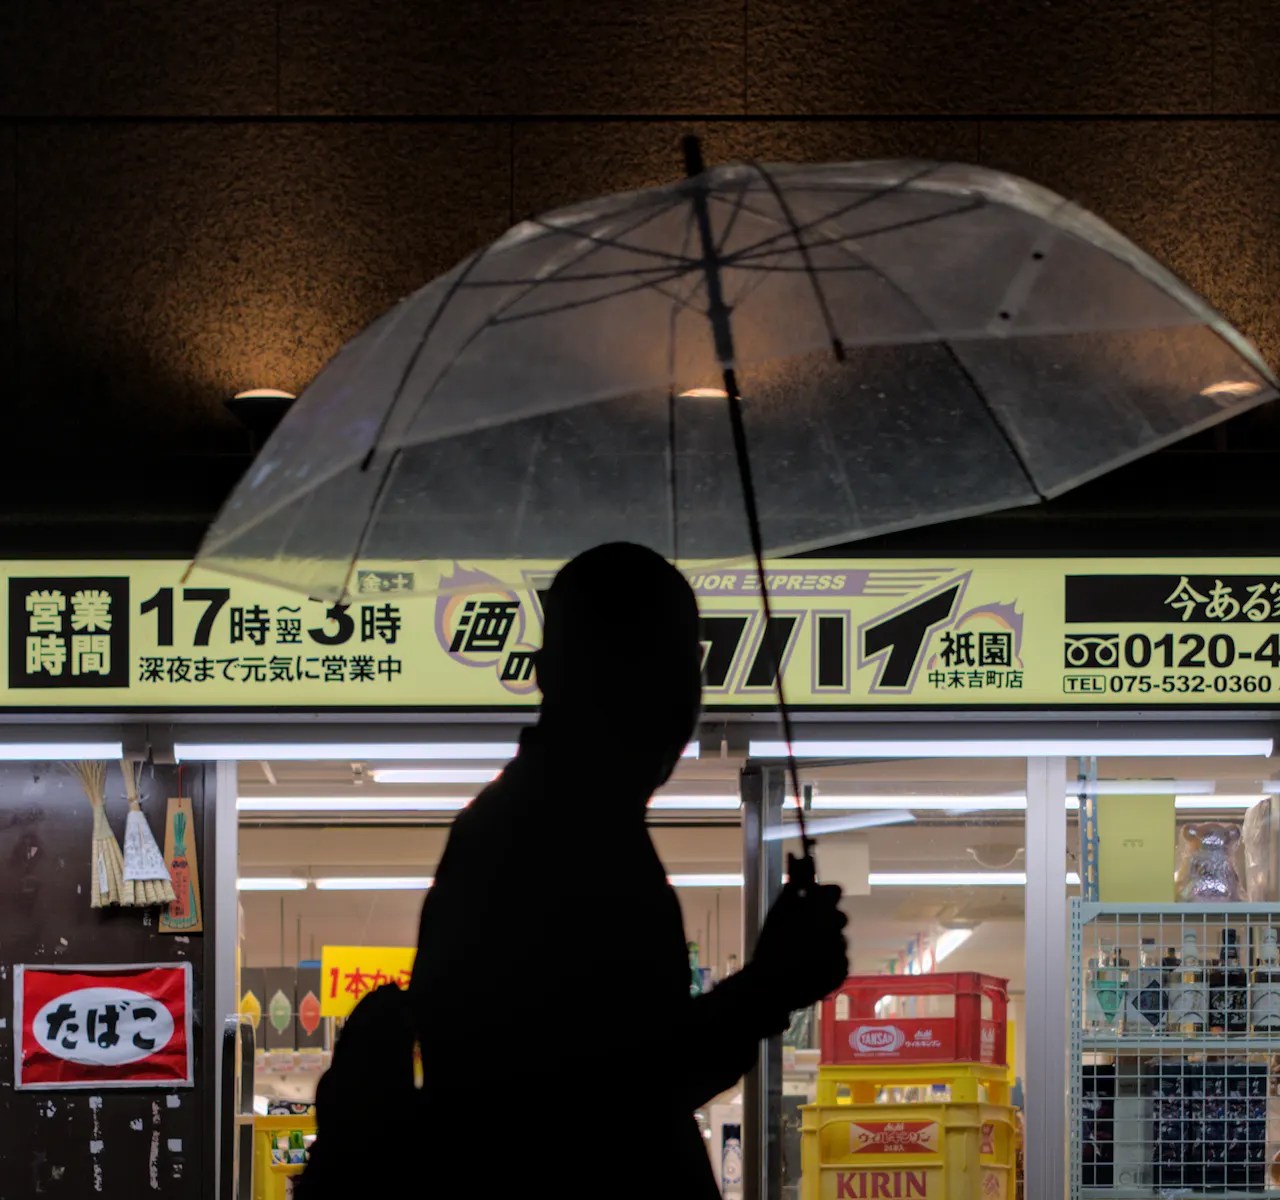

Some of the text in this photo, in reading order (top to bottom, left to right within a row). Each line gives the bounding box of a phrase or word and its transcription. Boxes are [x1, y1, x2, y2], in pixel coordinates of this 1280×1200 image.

[690, 574, 846, 590] UOR EXPRESS
[25, 589, 113, 633] 営業
[25, 634, 112, 676] 時間
[939, 631, 1013, 669] 祇園
[138, 655, 403, 683] 深夜まで元気に営業中
[928, 669, 1024, 690] 中末吉町店
[1066, 677, 1103, 692] TEL
[1109, 675, 1273, 693] 075-532-0360
[46, 1001, 157, 1050] たばこ
[837, 1171, 927, 1199] KIRIN
